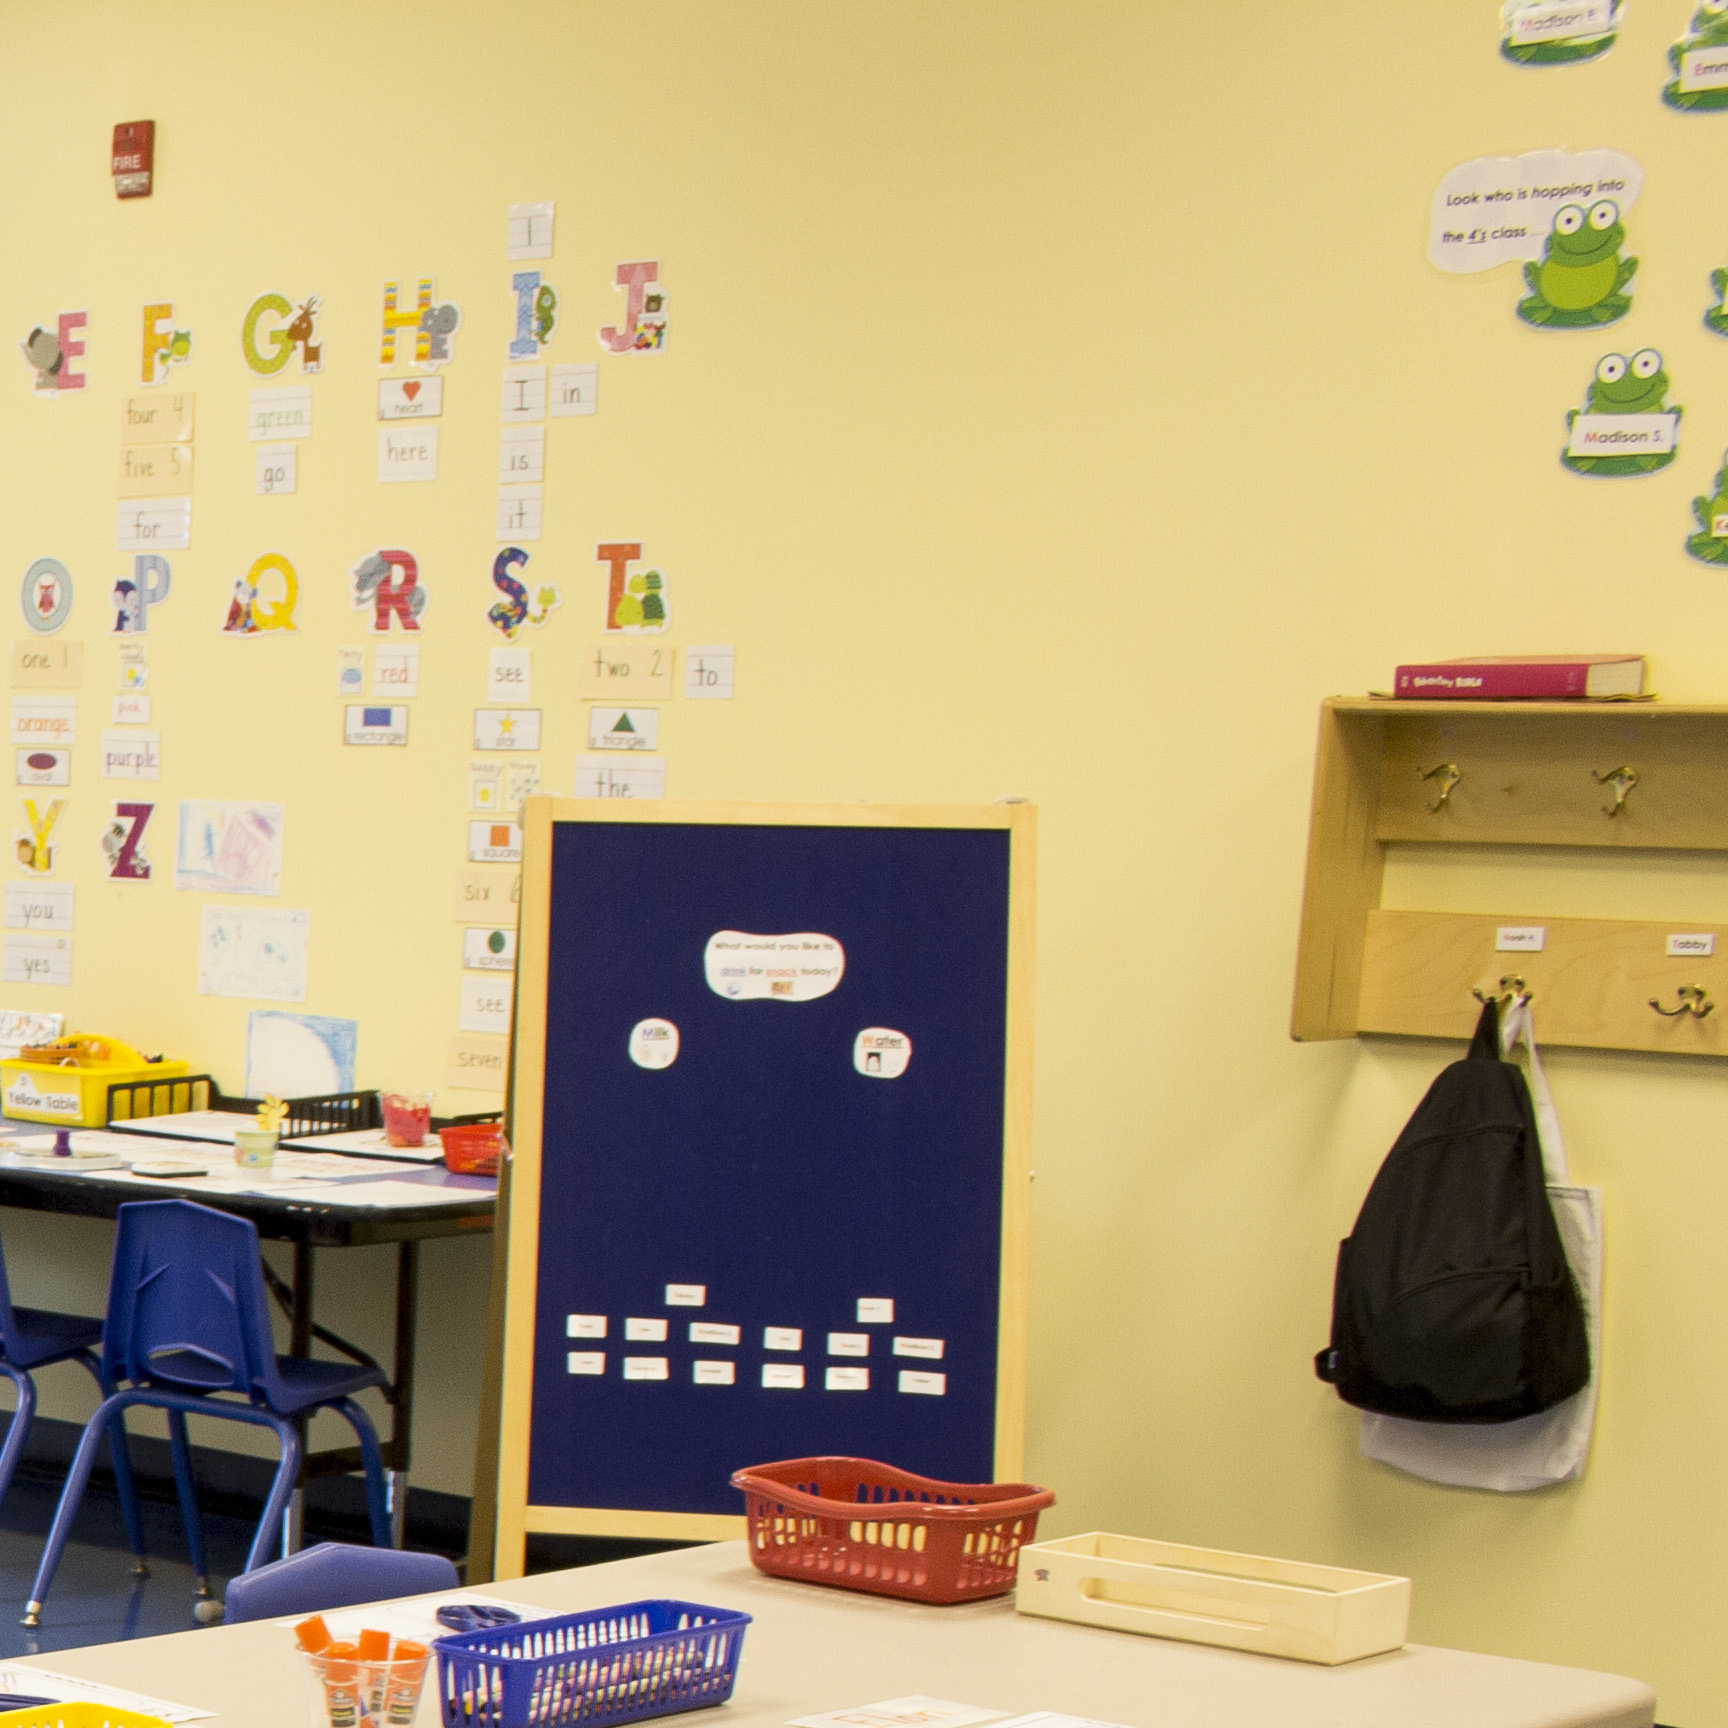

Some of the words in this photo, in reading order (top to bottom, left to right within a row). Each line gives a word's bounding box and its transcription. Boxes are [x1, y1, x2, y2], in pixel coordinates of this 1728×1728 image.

[1446, 192, 1480, 206] Look
[1484, 188, 1513, 202] who
[1517, 187, 1527, 200] is
[1530, 181, 1593, 200] hopping
[1597, 179, 1625, 193] into
[1443, 230, 1464, 243] the
[1490, 226, 1527, 240] class
[508, 271, 541, 359] I
[599, 261, 659, 352] J
[243, 293, 296, 375] G
[380, 279, 432, 364] H
[56, 311, 88, 391] E
[140, 303, 173, 383] F
[562, 381, 582, 404] in
[125, 399, 156, 425] four
[256, 408, 304, 437] green
[386, 435, 429, 463] here
[1583, 430, 1648, 444] Madison
[124, 450, 155, 477] five
[169, 447, 181, 476] 5
[510, 450, 529, 471] is
[263, 465, 286, 492] go
[132, 510, 162, 540] for
[21, 557, 74, 632] O
[133, 554, 172, 632] P
[245, 552, 299, 631] Q
[374, 549, 421, 631] R
[488, 546, 529, 636] S
[597, 542, 642, 630] T
[21, 653, 51, 669] one
[380, 655, 409, 684] red
[494, 666, 525, 683] see
[593, 649, 630, 678] two
[650, 648, 664, 677] 2
[695, 658, 718, 687] to
[16, 716, 70, 739] orange
[105, 741, 157, 775] purple
[595, 768, 633, 798] the
[21, 798, 66, 871] Y
[109, 802, 156, 880] Z
[464, 884, 491, 901] six
[22, 902, 55, 928] you
[744, 942, 777, 951] would
[779, 943, 800, 952] you
[802, 942, 822, 951] like
[23, 957, 51, 981] yes
[749, 966, 764, 976] for
[765, 966, 798, 977] snack
[475, 998, 506, 1014] see
[643, 1027, 669, 1039] Milk
[861, 1034, 904, 1046] Water
[457, 1051, 503, 1070] seven
